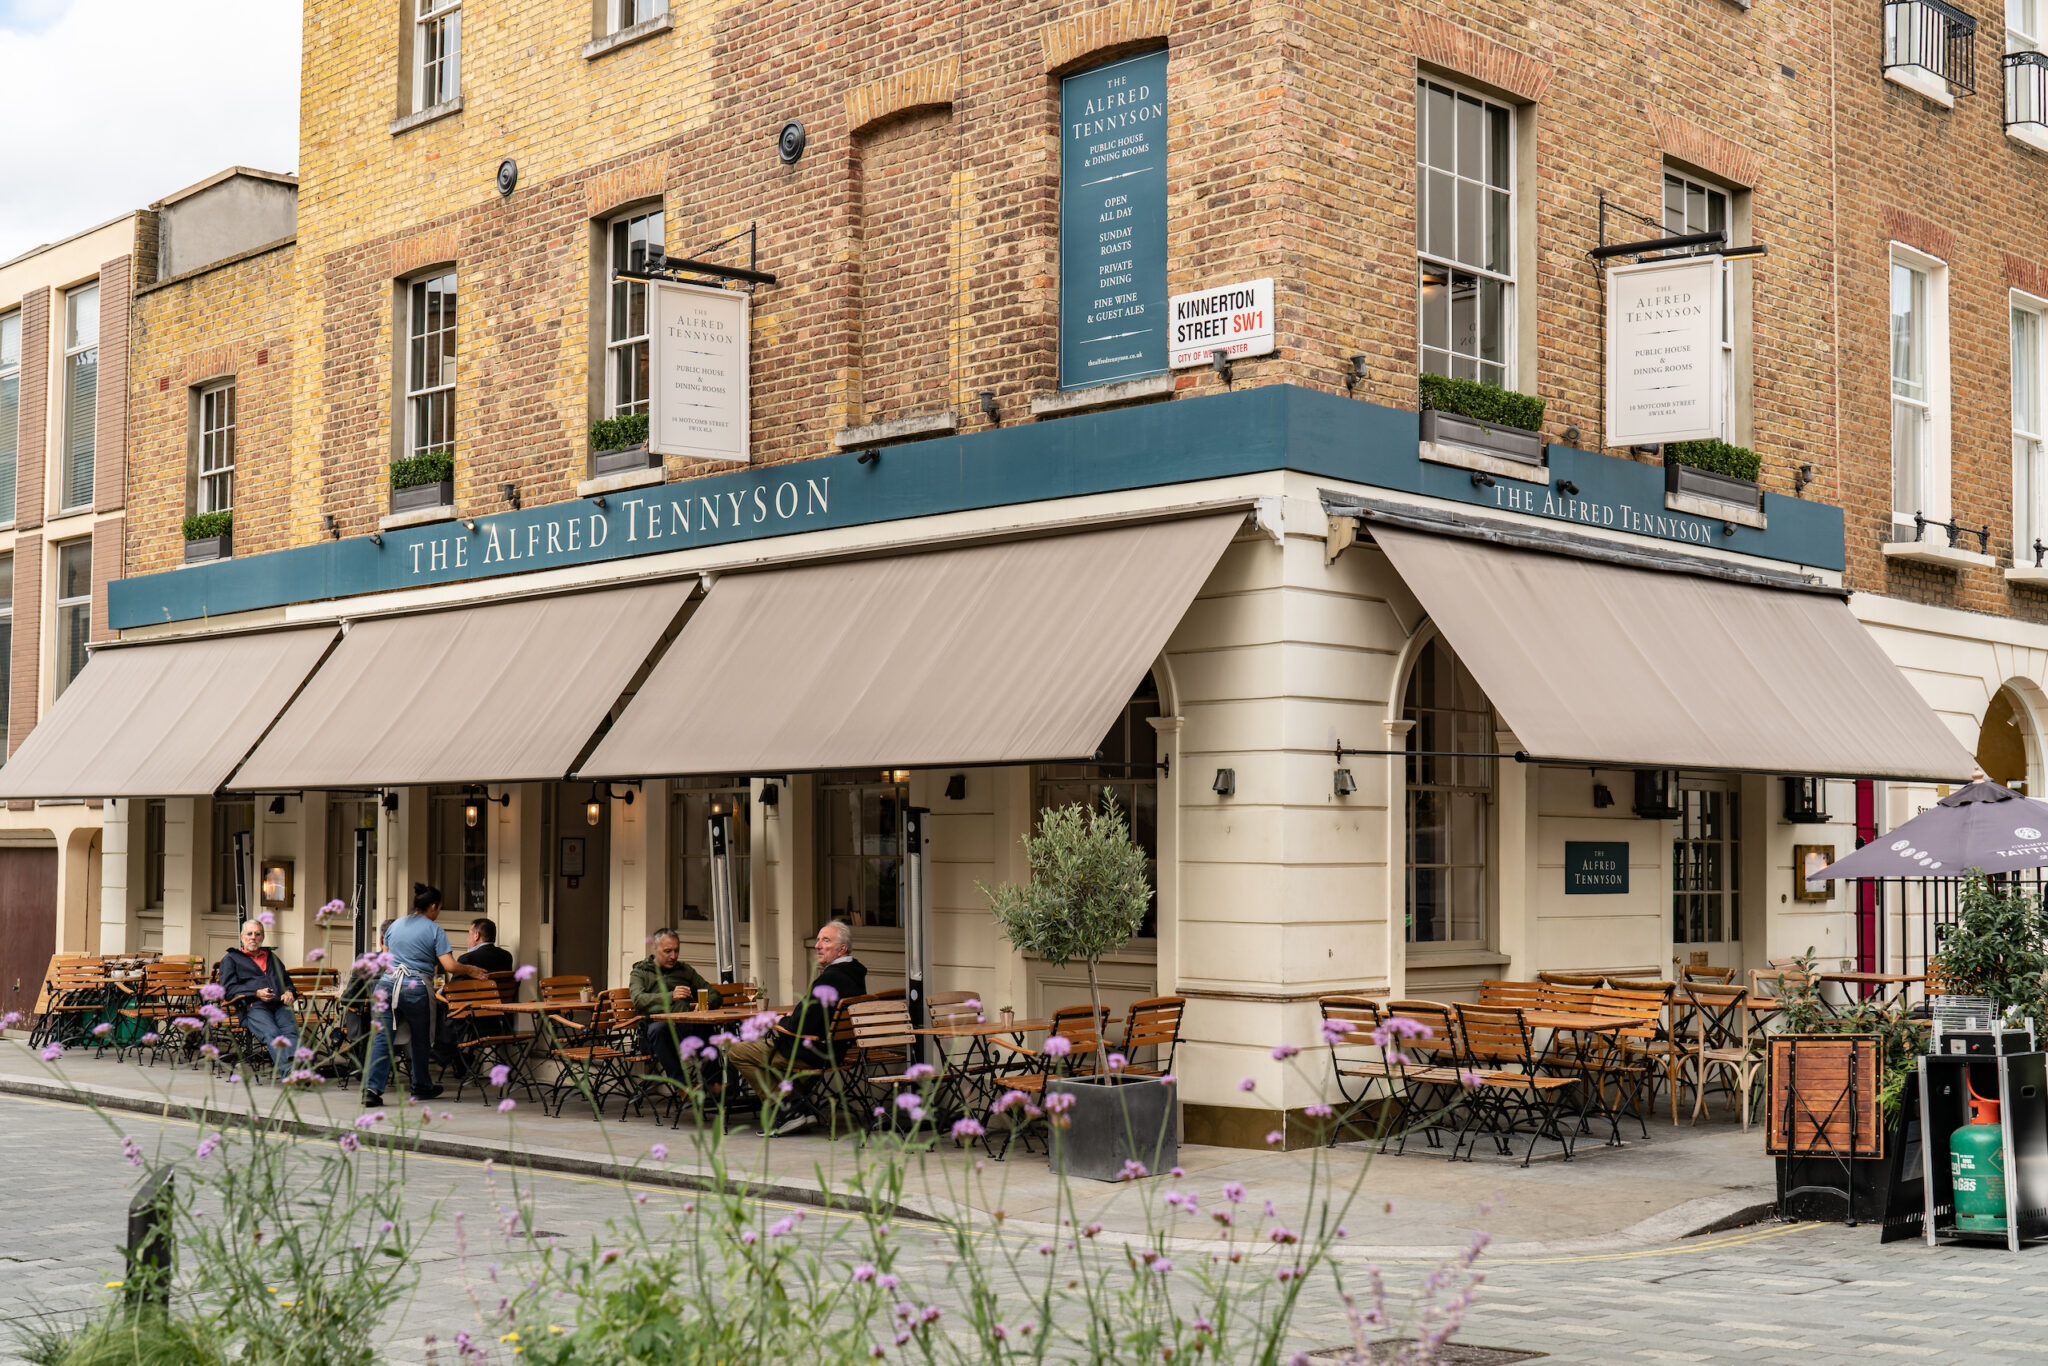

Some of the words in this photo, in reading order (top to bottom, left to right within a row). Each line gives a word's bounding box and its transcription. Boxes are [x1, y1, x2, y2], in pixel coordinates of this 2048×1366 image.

[1107, 76, 1127, 88] THE
[1084, 86, 1150, 116] ALFRED
[1072, 103, 1162, 140] TENNYSON
[1090, 140, 1116, 154] PUBLIC
[1118, 133, 1144, 147] HOUSE
[1084, 159, 1090, 167] &
[1092, 151, 1120, 165] DINING
[1122, 144, 1149, 158] ROOMS
[1104, 194, 1128, 208] OPEN
[1100, 212, 1114, 222] ALL
[1116, 206, 1133, 218] DAY
[1099, 226, 1132, 243] SUNDAY
[1100, 240, 1132, 256] ROASTS
[1099, 260, 1133, 275] PRIVATE
[1100, 274, 1132, 288] DINING
[1094, 297, 1113, 309] FINE
[1114, 292, 1138, 304] WINE
[1178, 289, 1254, 320] KINNERTON
[1636, 293, 1691, 308] ALFRED
[1087, 315, 1094, 324] &
[1096, 308, 1124, 322] GUEST
[1124, 304, 1144, 316] ALES
[1626, 305, 1701, 323] TENNYSON
[677, 315, 724, 330] ALFRED
[1178, 317, 1228, 342] STREET
[1233, 310, 1263, 333] SW1
[668, 327, 732, 344] TENNYSON
[1178, 353, 1191, 363] CITY
[1193, 352, 1201, 360] OF
[1635, 348, 1663, 357] PUBLIC
[1664, 345, 1691, 354] HOUSE
[676, 364, 700, 374] PUBLIC
[702, 368, 725, 376] HOUSE
[1634, 367, 1663, 375] DINING
[1664, 363, 1693, 372] ROOMS
[675, 382, 700, 391] DINING
[1494, 485, 1534, 512] THE
[1542, 490, 1614, 525] ALFRED
[1619, 504, 1712, 544] TENNYSON
[409, 536, 468, 574] THE
[482, 513, 608, 564] ALFRED
[622, 476, 830, 542] TENNYSON
[1996, 846, 2048, 857] TAITTI
[1582, 859, 1616, 870] ALFRED
[1574, 873, 1622, 884] TENNYSON
[1958, 1178, 1976, 1192] Gas
